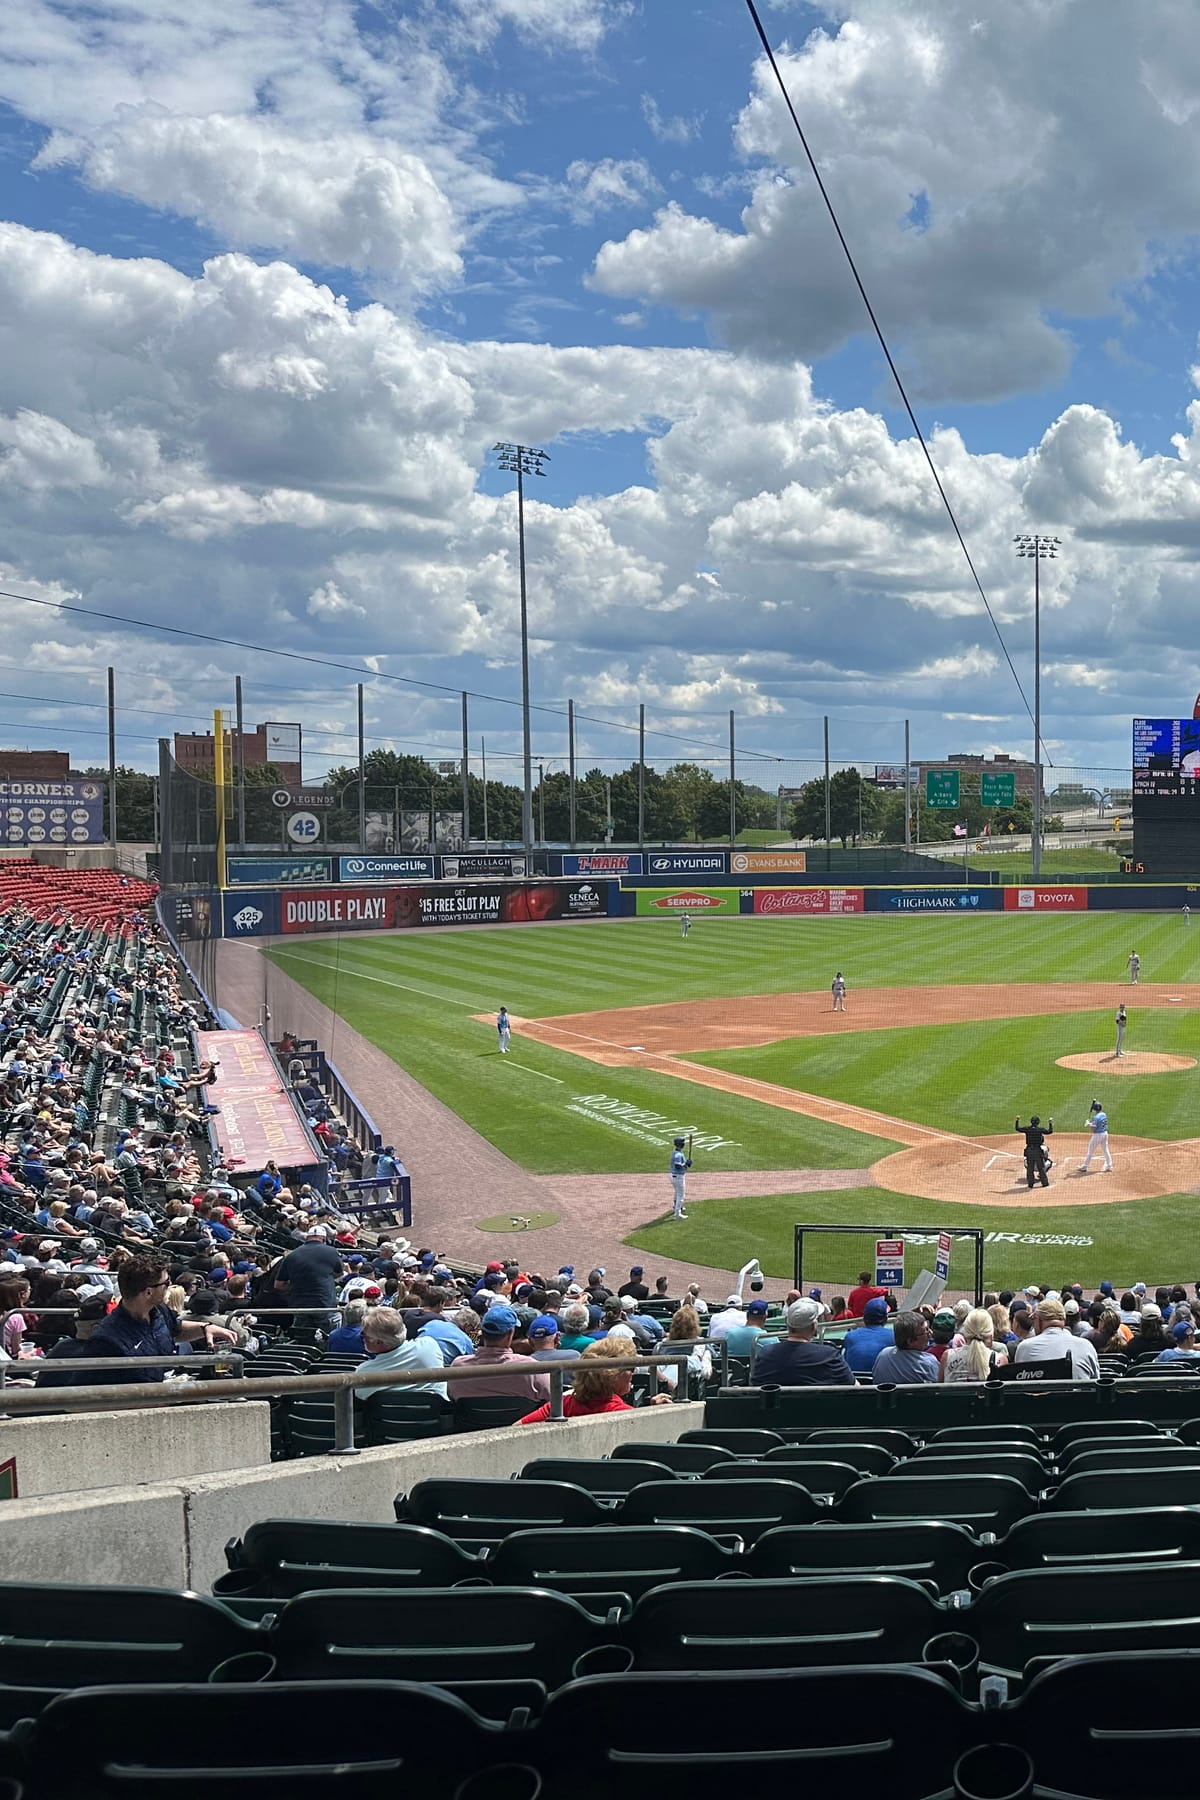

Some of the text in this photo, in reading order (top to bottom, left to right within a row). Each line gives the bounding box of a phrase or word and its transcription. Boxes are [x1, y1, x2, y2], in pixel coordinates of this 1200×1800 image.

[293, 819, 316, 836] 42
[578, 856, 630, 870] T-MARK
[673, 859, 721, 868] HYUNDAI
[750, 859, 801, 867] EVANS BANK
[569, 893, 600, 902] SENECA
[667, 898, 711, 906] SERVPRO
[898, 897, 956, 908] HIGHMARK
[1037, 894, 1075, 903] TOYOTA
[419, 896, 500, 913] $15 FREE SLOT PLAY
[287, 898, 386, 923] DOUBLE PLAY!
[239, 911, 259, 921] 325
[572, 1094, 678, 1132] ROSWELL
[1020, 1238, 1094, 1246] GUARD
[1024, 1233, 1092, 1241] NATIONAL
[1016, 1370, 1044, 1380] drive
